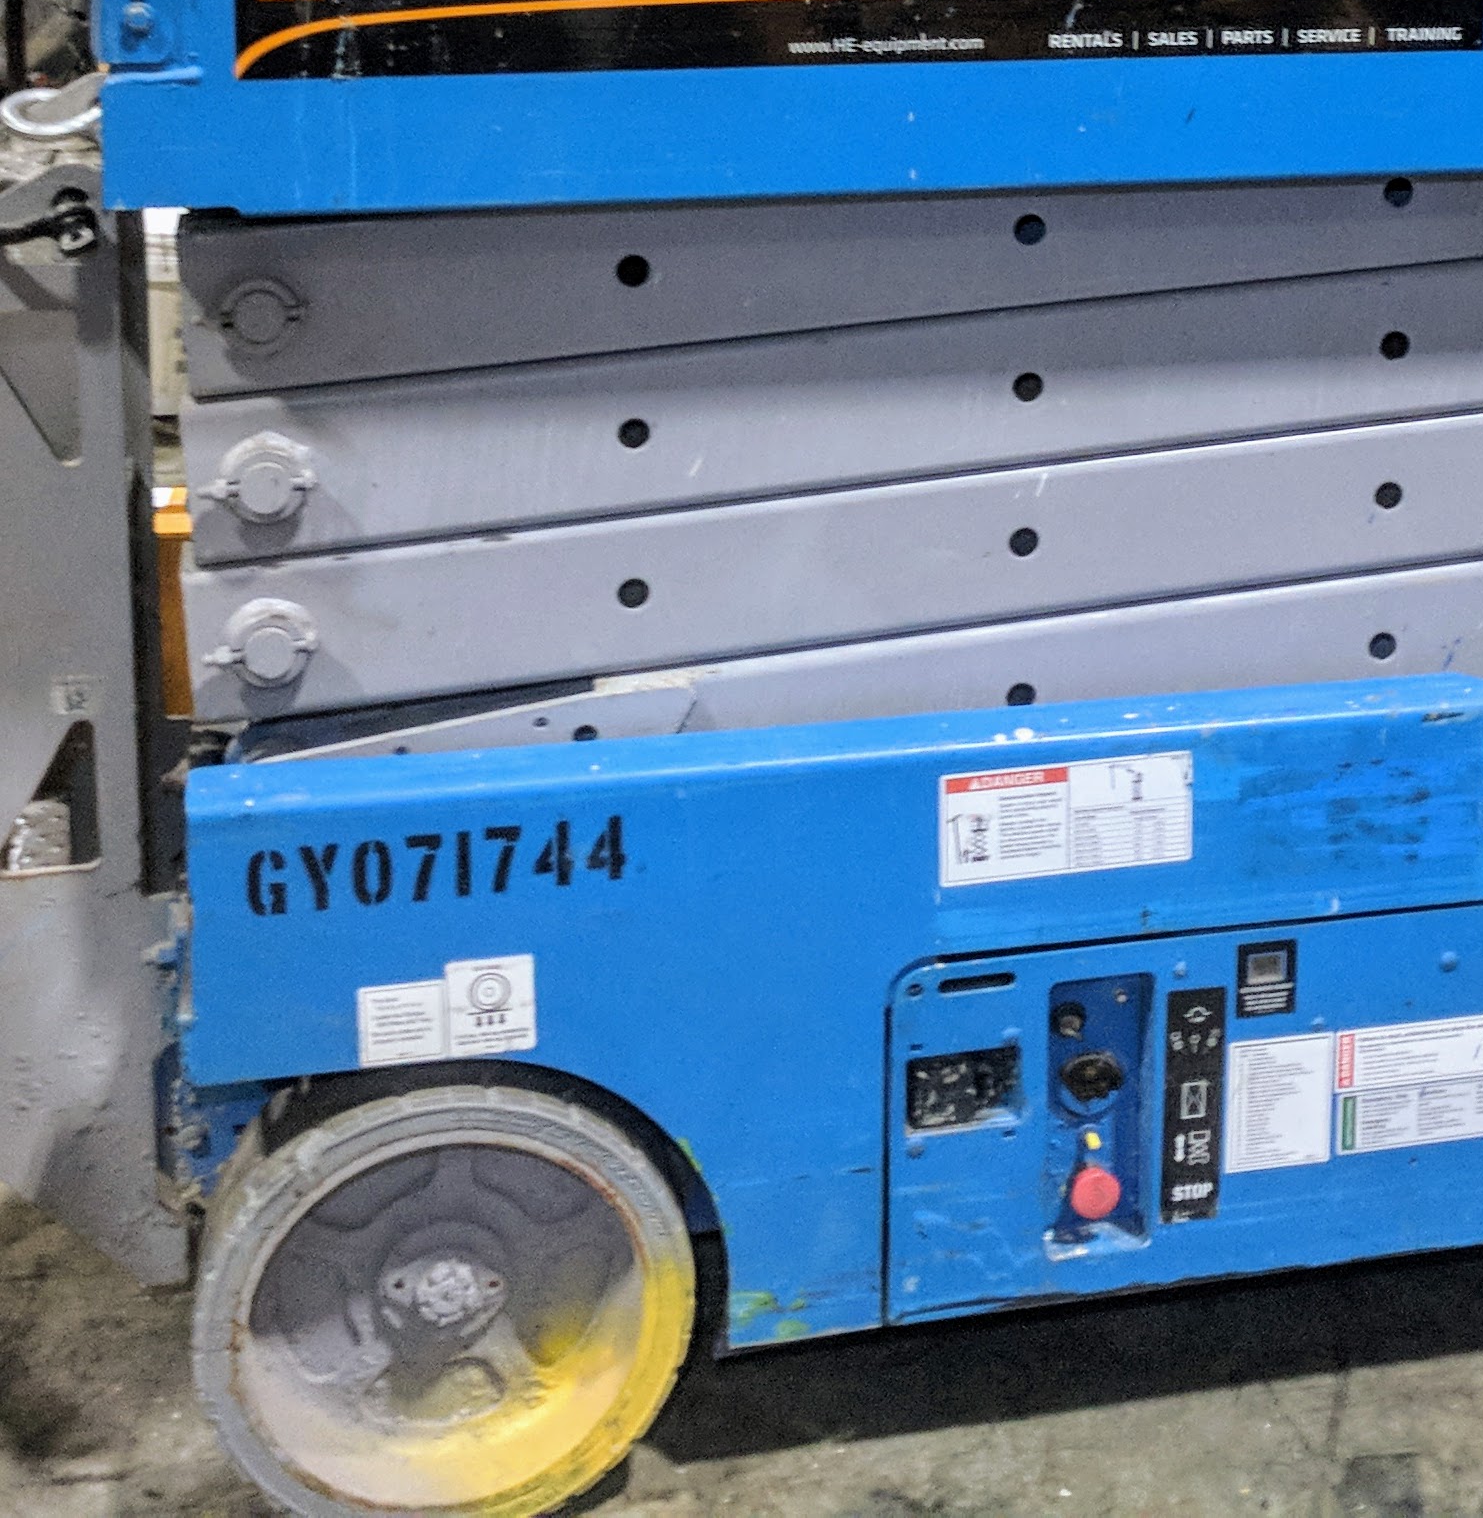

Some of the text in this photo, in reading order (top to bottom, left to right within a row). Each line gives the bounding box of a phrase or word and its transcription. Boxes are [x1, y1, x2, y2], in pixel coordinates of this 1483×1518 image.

[788, 33, 985, 54] www.HE-equipment.com
[1047, 26, 1463, 49] RENTALS SALES PARTS SERVICE TRAINING
[980, 770, 1045, 789] DANGER
[246, 815, 627, 916] GY071744
[1171, 1182, 1214, 1202] STOP
